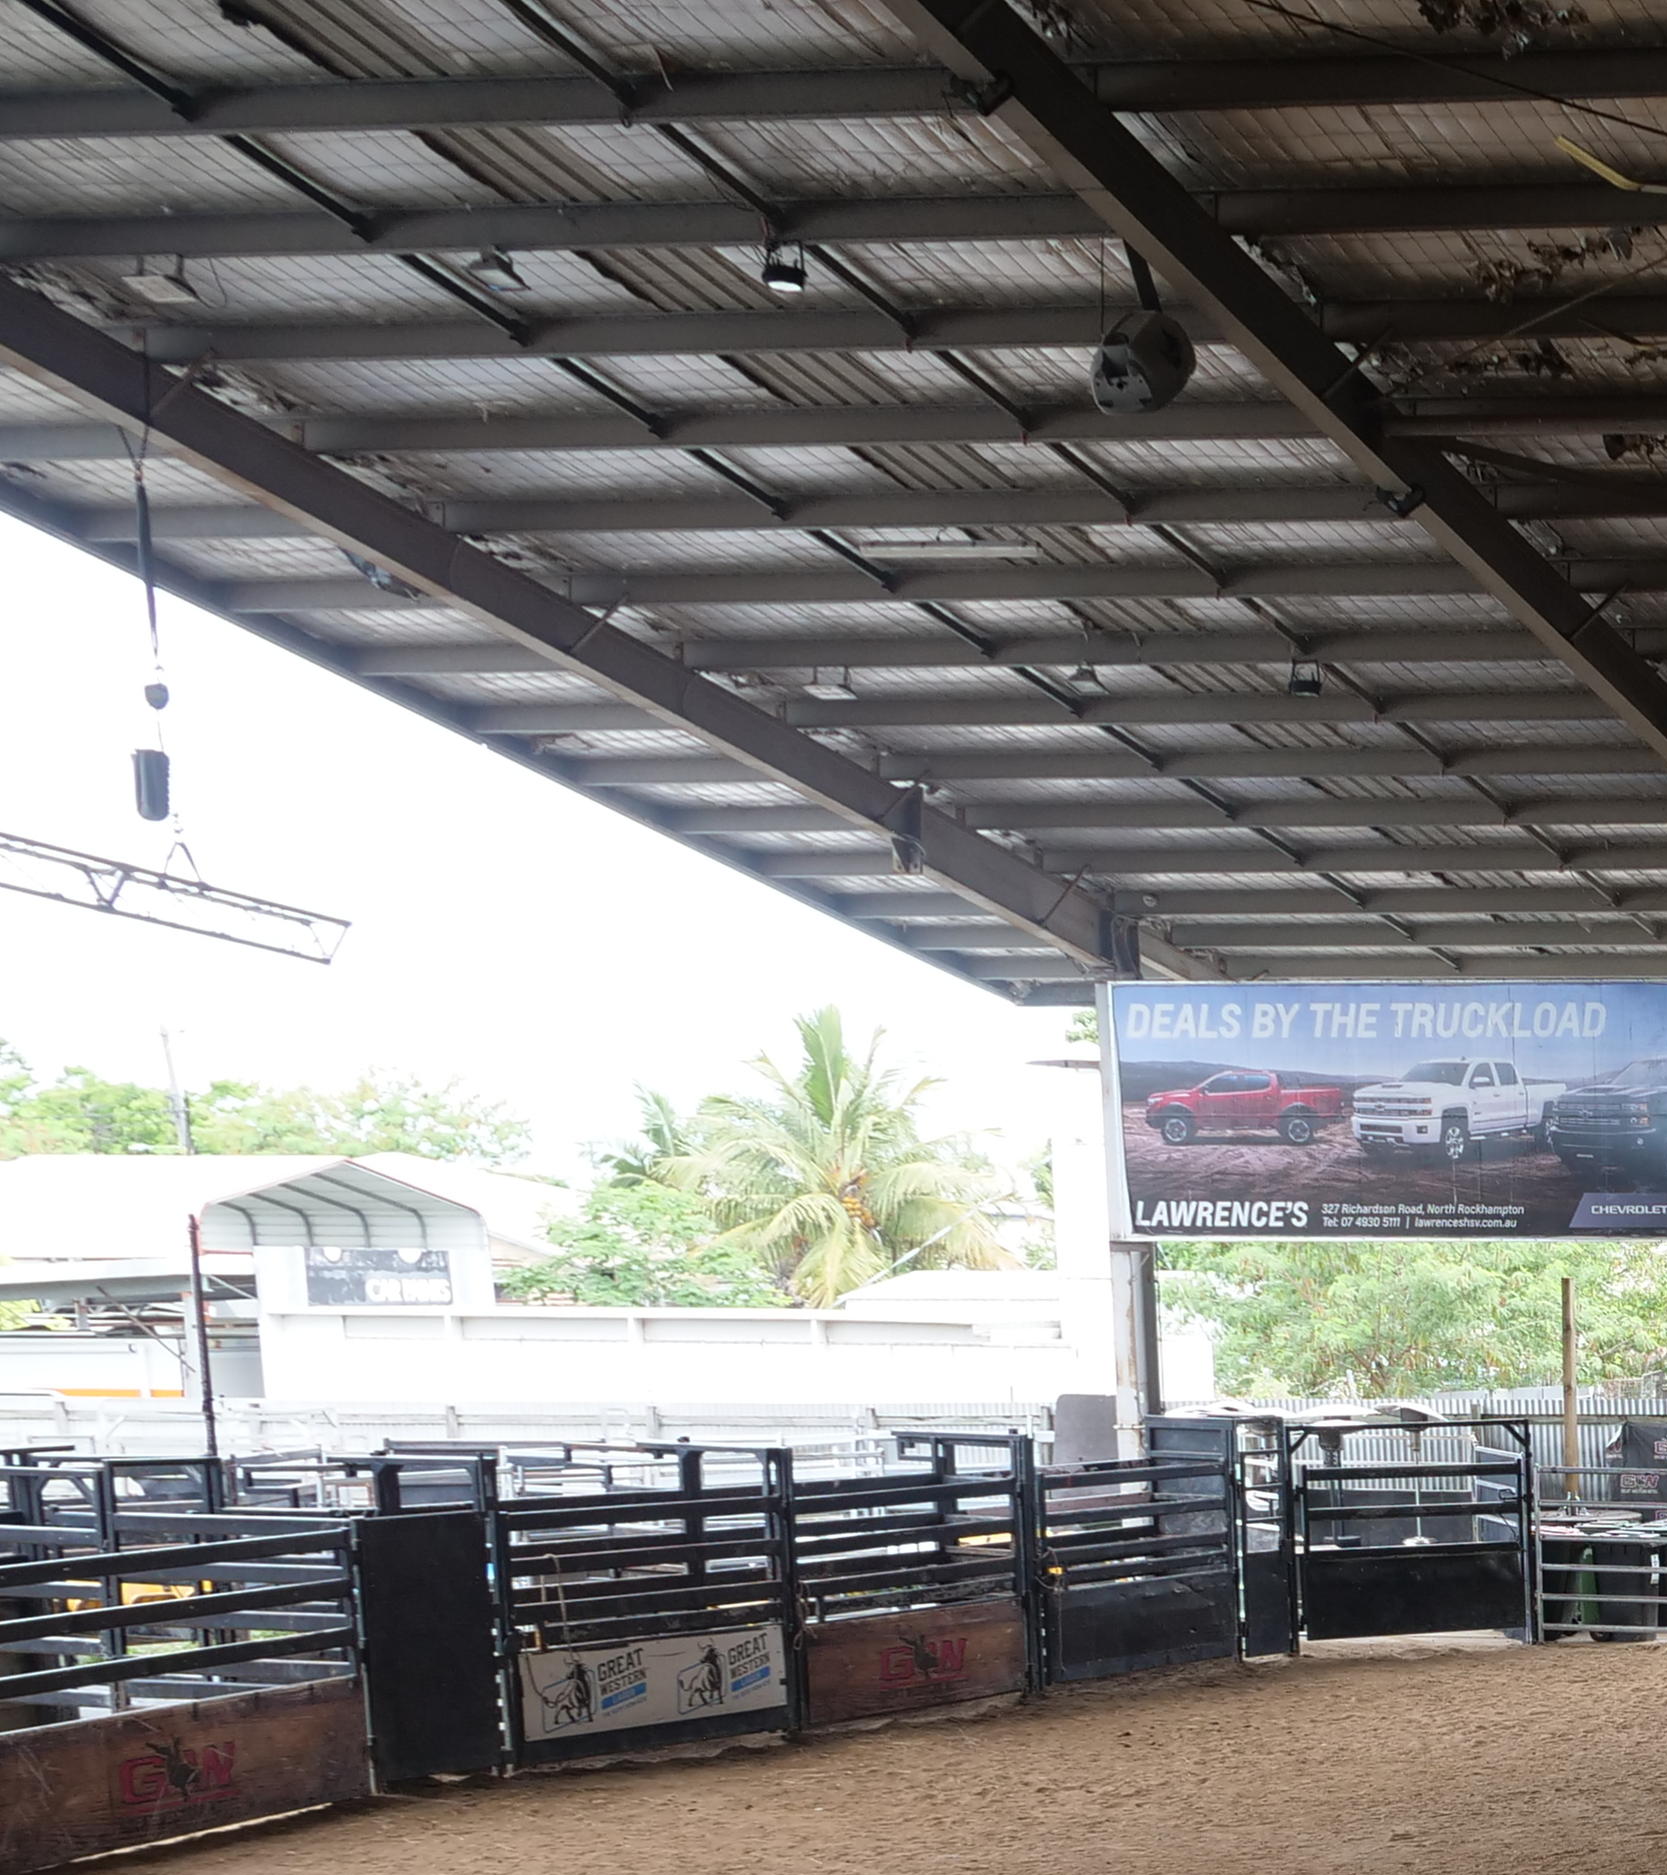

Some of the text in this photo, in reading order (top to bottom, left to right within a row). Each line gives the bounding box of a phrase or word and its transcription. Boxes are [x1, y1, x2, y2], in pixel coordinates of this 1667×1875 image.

[1126, 1002, 1608, 1039] DEALS BY THE TRUCKLOAD
[1135, 1200, 1309, 1228] LAWRENCE'S
[1321, 1203, 1340, 1215] 327
[1427, 1203, 1455, 1215] North
[1457, 1203, 1525, 1217] Rockhampton
[1341, 1216, 1353, 1228] 07
[1355, 1216, 1381, 1228] 4930
[1414, 1215, 1518, 1228] lawrenceshsv.com.au
[728, 1632, 768, 1665] GREAT
[597, 1648, 644, 1682] GREAT
[600, 1669, 648, 1697] WESTERN
